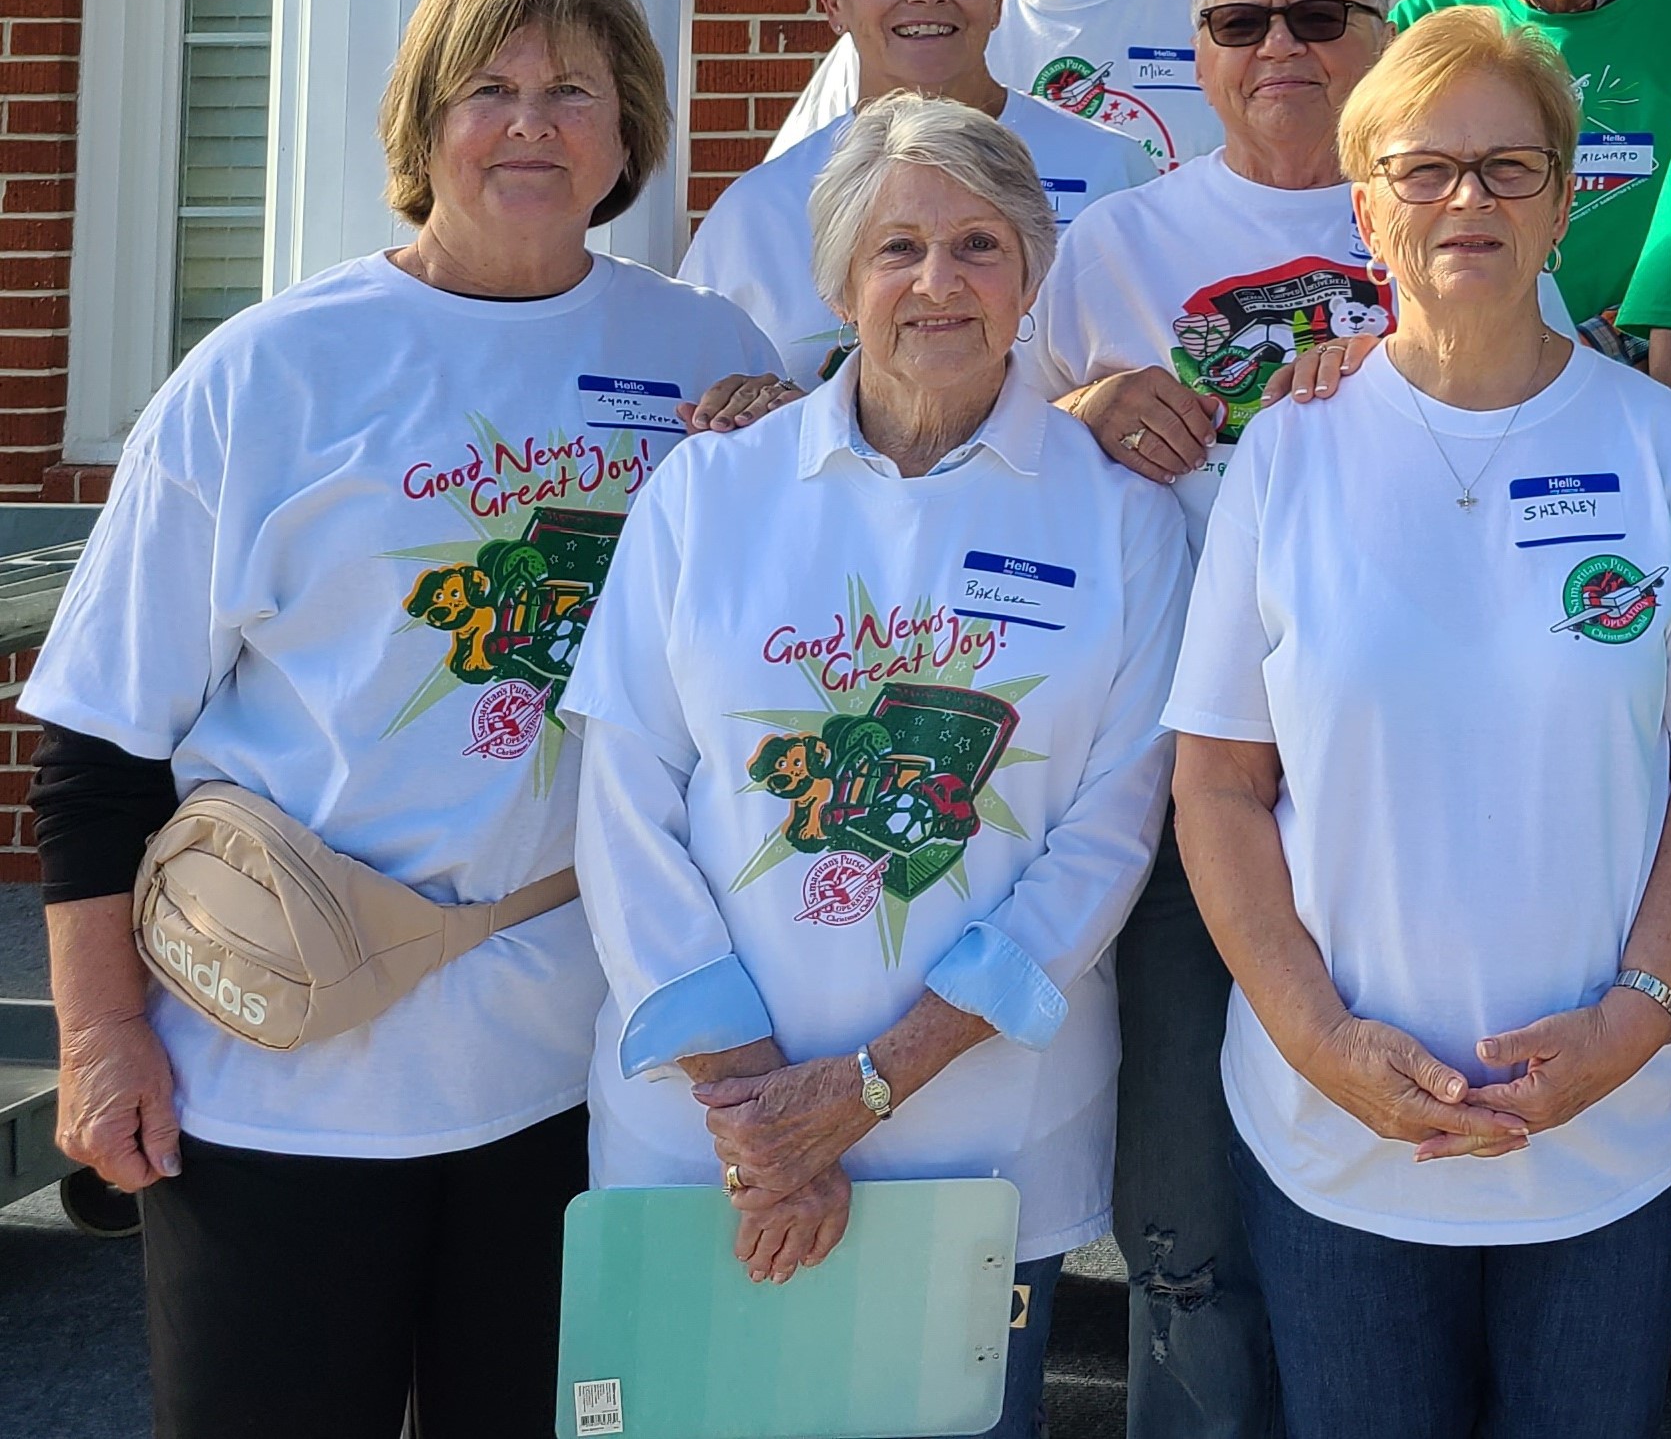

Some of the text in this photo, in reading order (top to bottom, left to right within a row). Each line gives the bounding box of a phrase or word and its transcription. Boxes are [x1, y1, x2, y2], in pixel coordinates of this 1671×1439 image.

[1066, 59, 1091, 77] Purse
[1139, 63, 1175, 80] Mike
[1602, 134, 1626, 142] Hello
[1580, 151, 1638, 164] RICHARD
[614, 380, 645, 391] Hello
[403, 435, 585, 499] Good News
[470, 438, 654, 517] Great Joy!
[1548, 477, 1581, 489] Hello
[1523, 499, 1596, 521] SHIRLEY
[1004, 559, 1037, 574] Hello
[1610, 558, 1638, 583] Purse
[1602, 598, 1649, 628] OPERATION
[763, 604, 946, 665] Good News
[821, 615, 1007, 692] Great Joy!
[509, 683, 532, 700] Purse
[840, 854, 866, 871] Purse
[152, 921, 268, 1025] adidas
